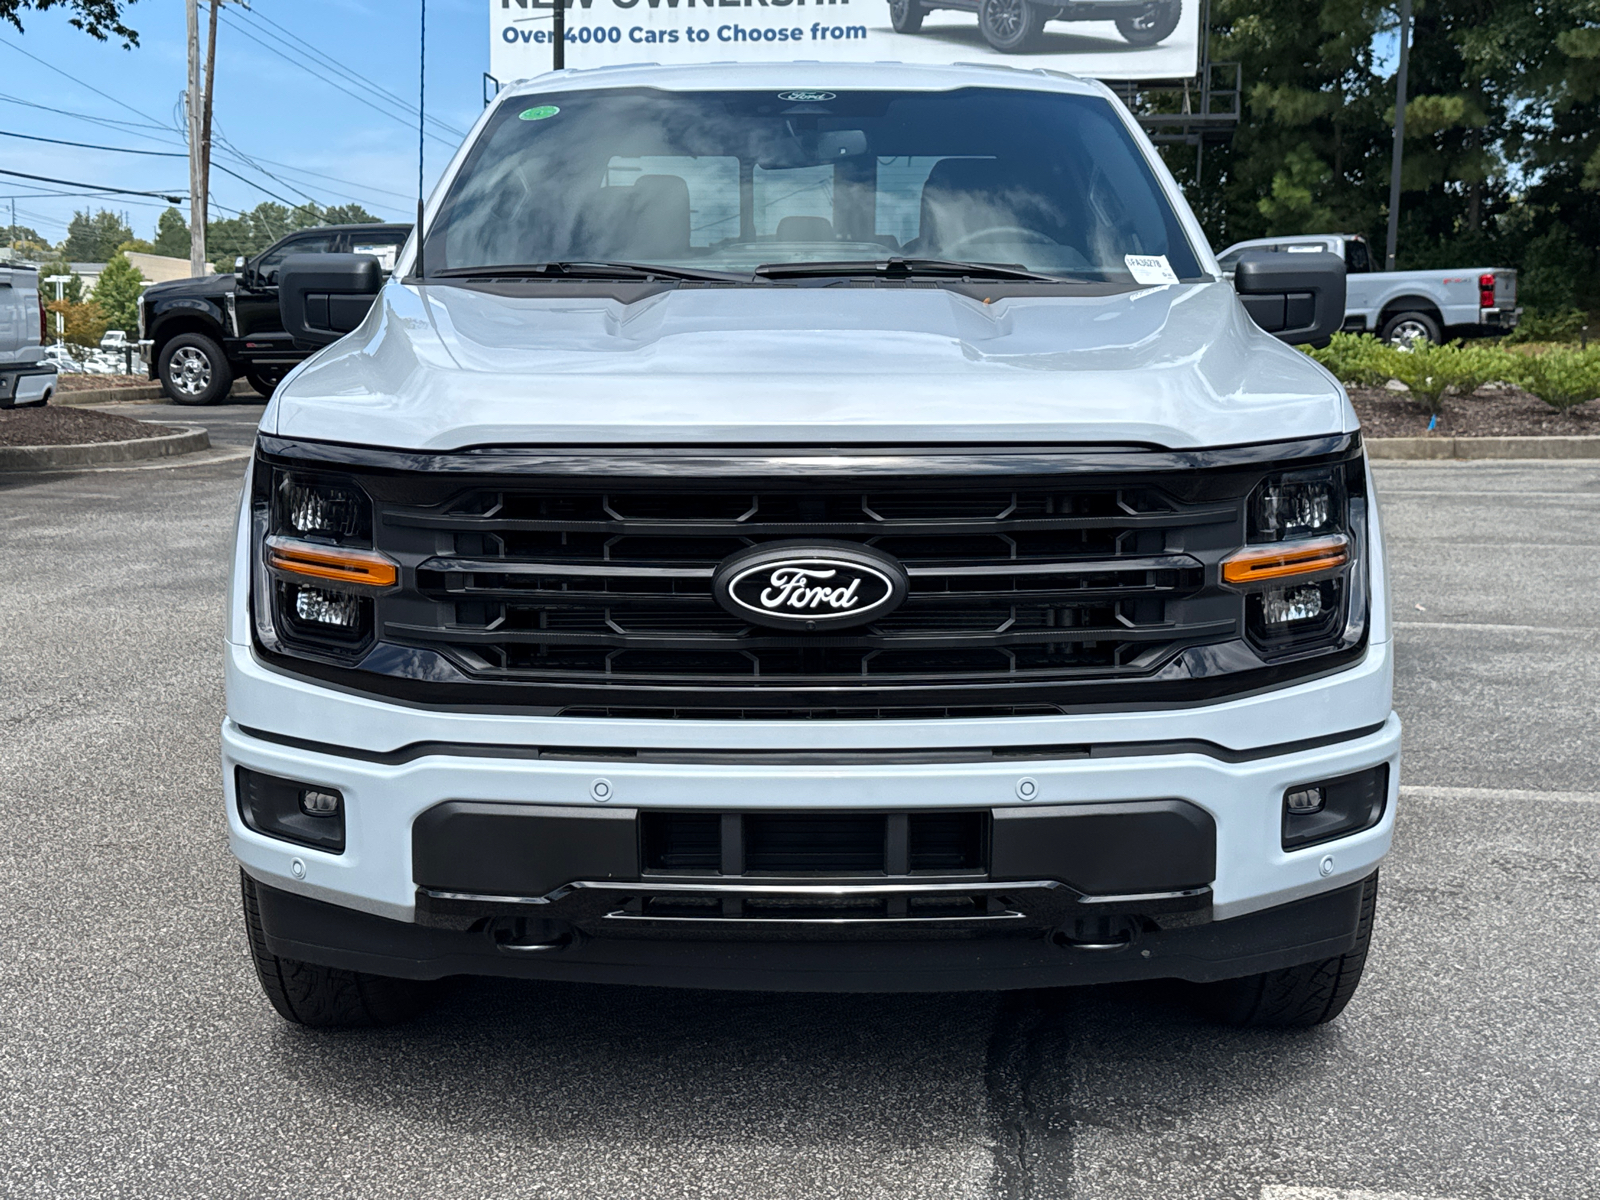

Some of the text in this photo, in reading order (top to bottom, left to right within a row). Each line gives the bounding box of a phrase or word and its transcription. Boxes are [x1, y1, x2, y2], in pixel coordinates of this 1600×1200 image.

[563, 26, 622, 43] 4000
[628, 26, 680, 43] Cars
[686, 26, 710, 42] to
[717, 24, 804, 42] Choose
[810, 22, 867, 40] from
[787, 91, 826, 100] Ford
[760, 567, 862, 608] Ford
